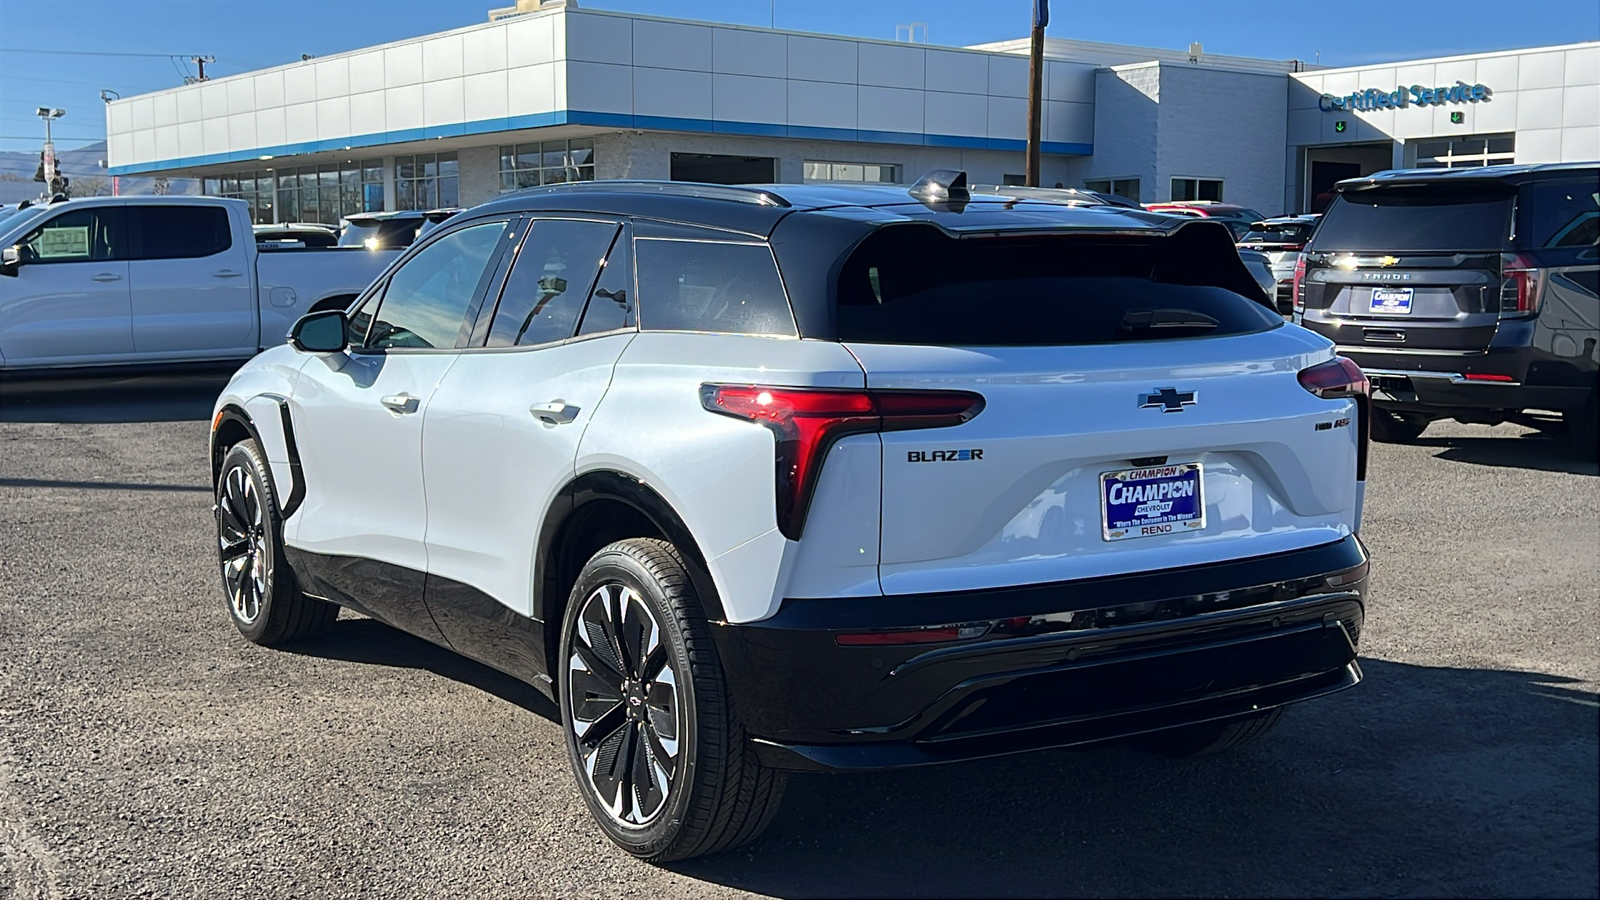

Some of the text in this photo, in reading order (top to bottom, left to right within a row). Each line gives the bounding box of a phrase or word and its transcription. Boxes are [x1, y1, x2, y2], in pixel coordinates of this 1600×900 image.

[1319, 80, 1492, 112] Certified Service
[1334, 418, 1350, 428] RS
[908, 449, 983, 462] BLAZER
[1130, 467, 1177, 480] CHAMPION
[1109, 480, 1194, 505] CHAMPION
[1137, 503, 1171, 513] CHEVROLET
[1141, 525, 1172, 535] RENO
